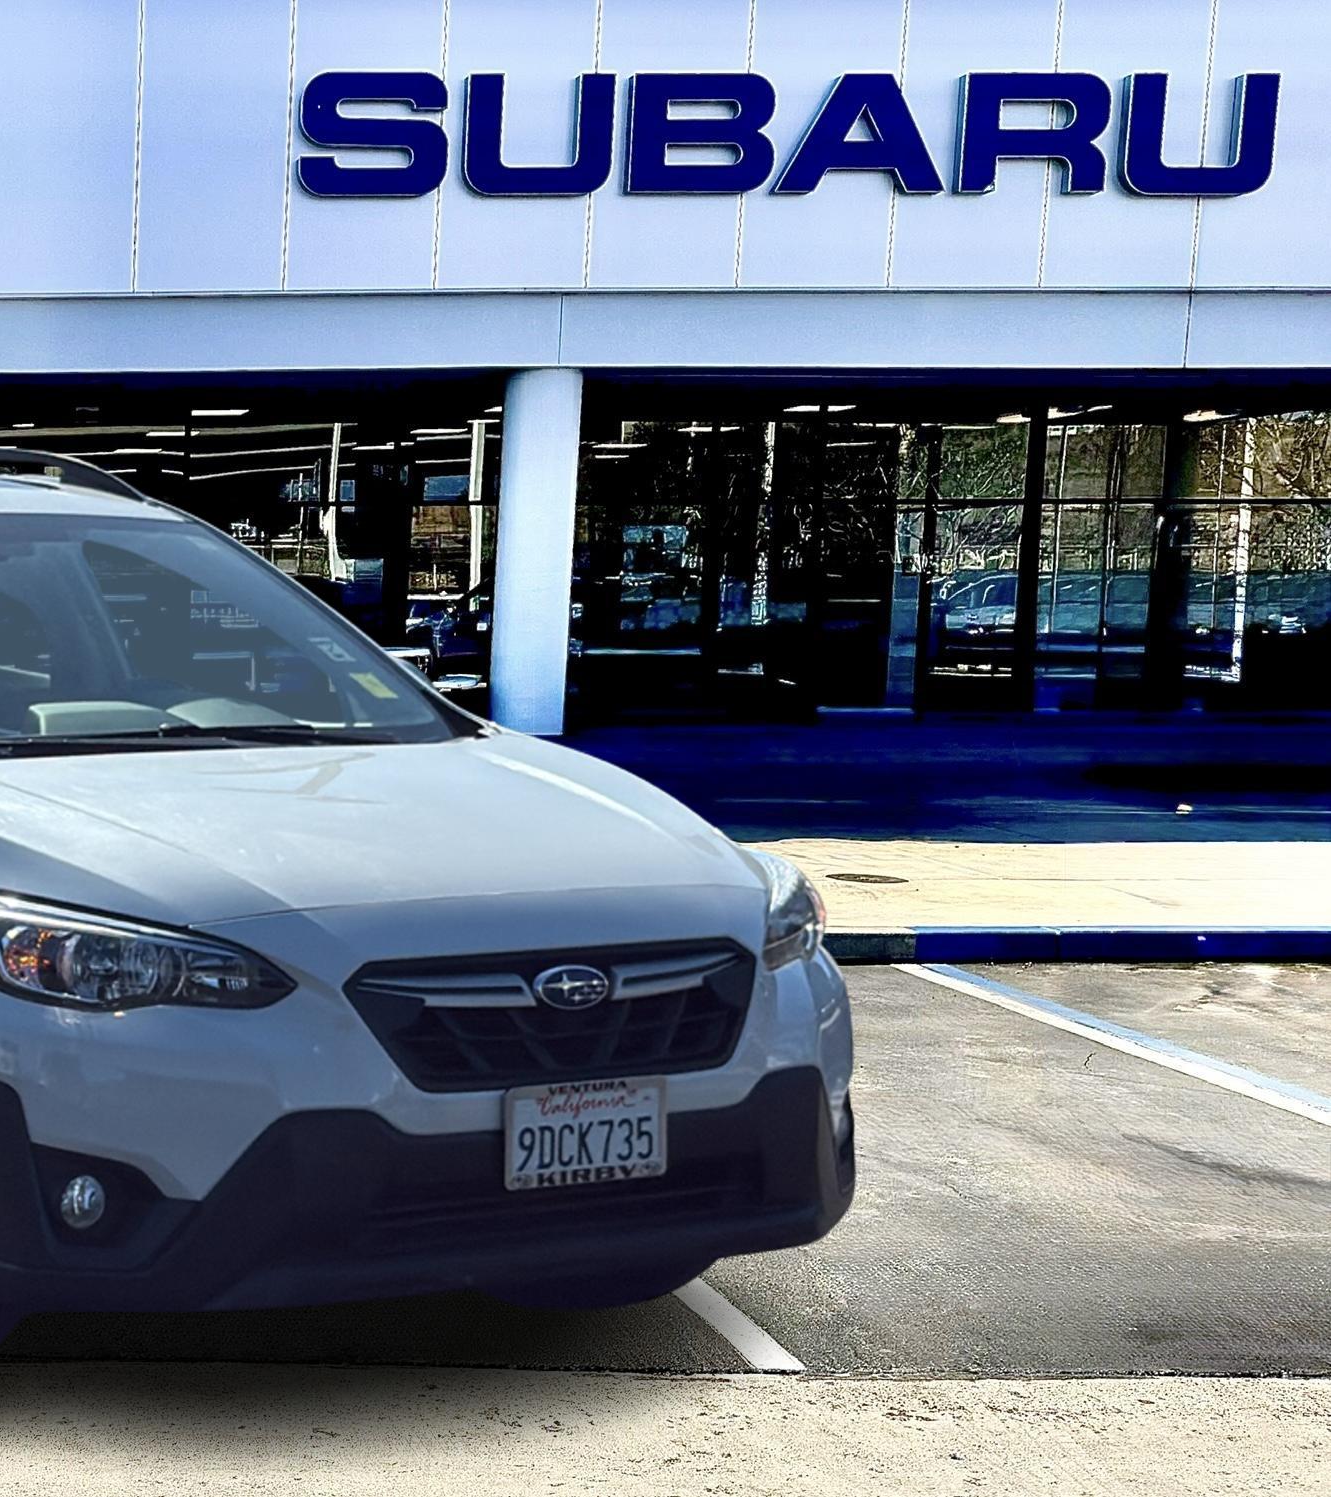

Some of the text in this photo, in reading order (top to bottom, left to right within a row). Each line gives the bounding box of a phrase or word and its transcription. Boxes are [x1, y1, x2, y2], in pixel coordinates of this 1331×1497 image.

[297, 71, 1281, 198] SUBARU
[548, 1080, 627, 1095] VENTURA
[536, 1089, 638, 1118] California
[517, 1115, 653, 1172] 9DCK735
[537, 1163, 636, 1185] KIRBY
